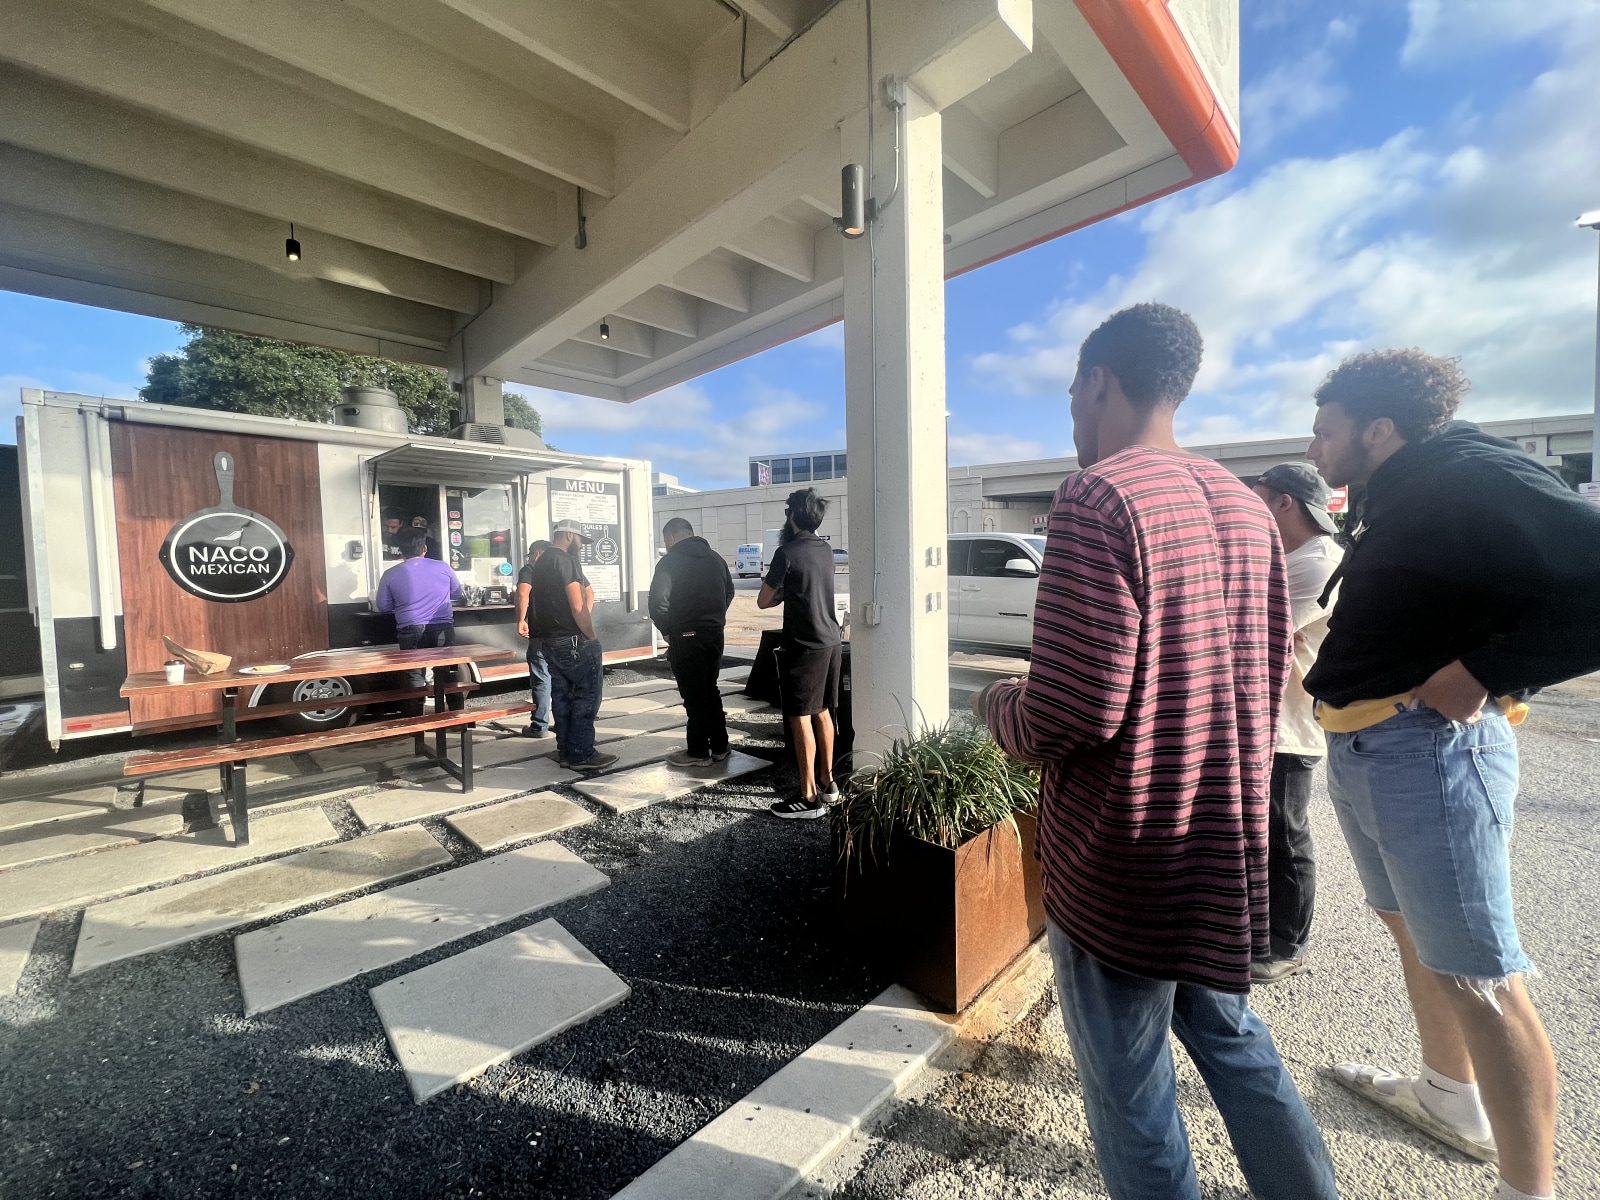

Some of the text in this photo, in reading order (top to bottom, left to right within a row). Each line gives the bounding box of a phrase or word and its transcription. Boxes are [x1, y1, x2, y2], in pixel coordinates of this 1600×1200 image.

[565, 479, 605, 493] MENU
[188, 546, 269, 562] NACO
[190, 563, 270, 575] MEXICAN
